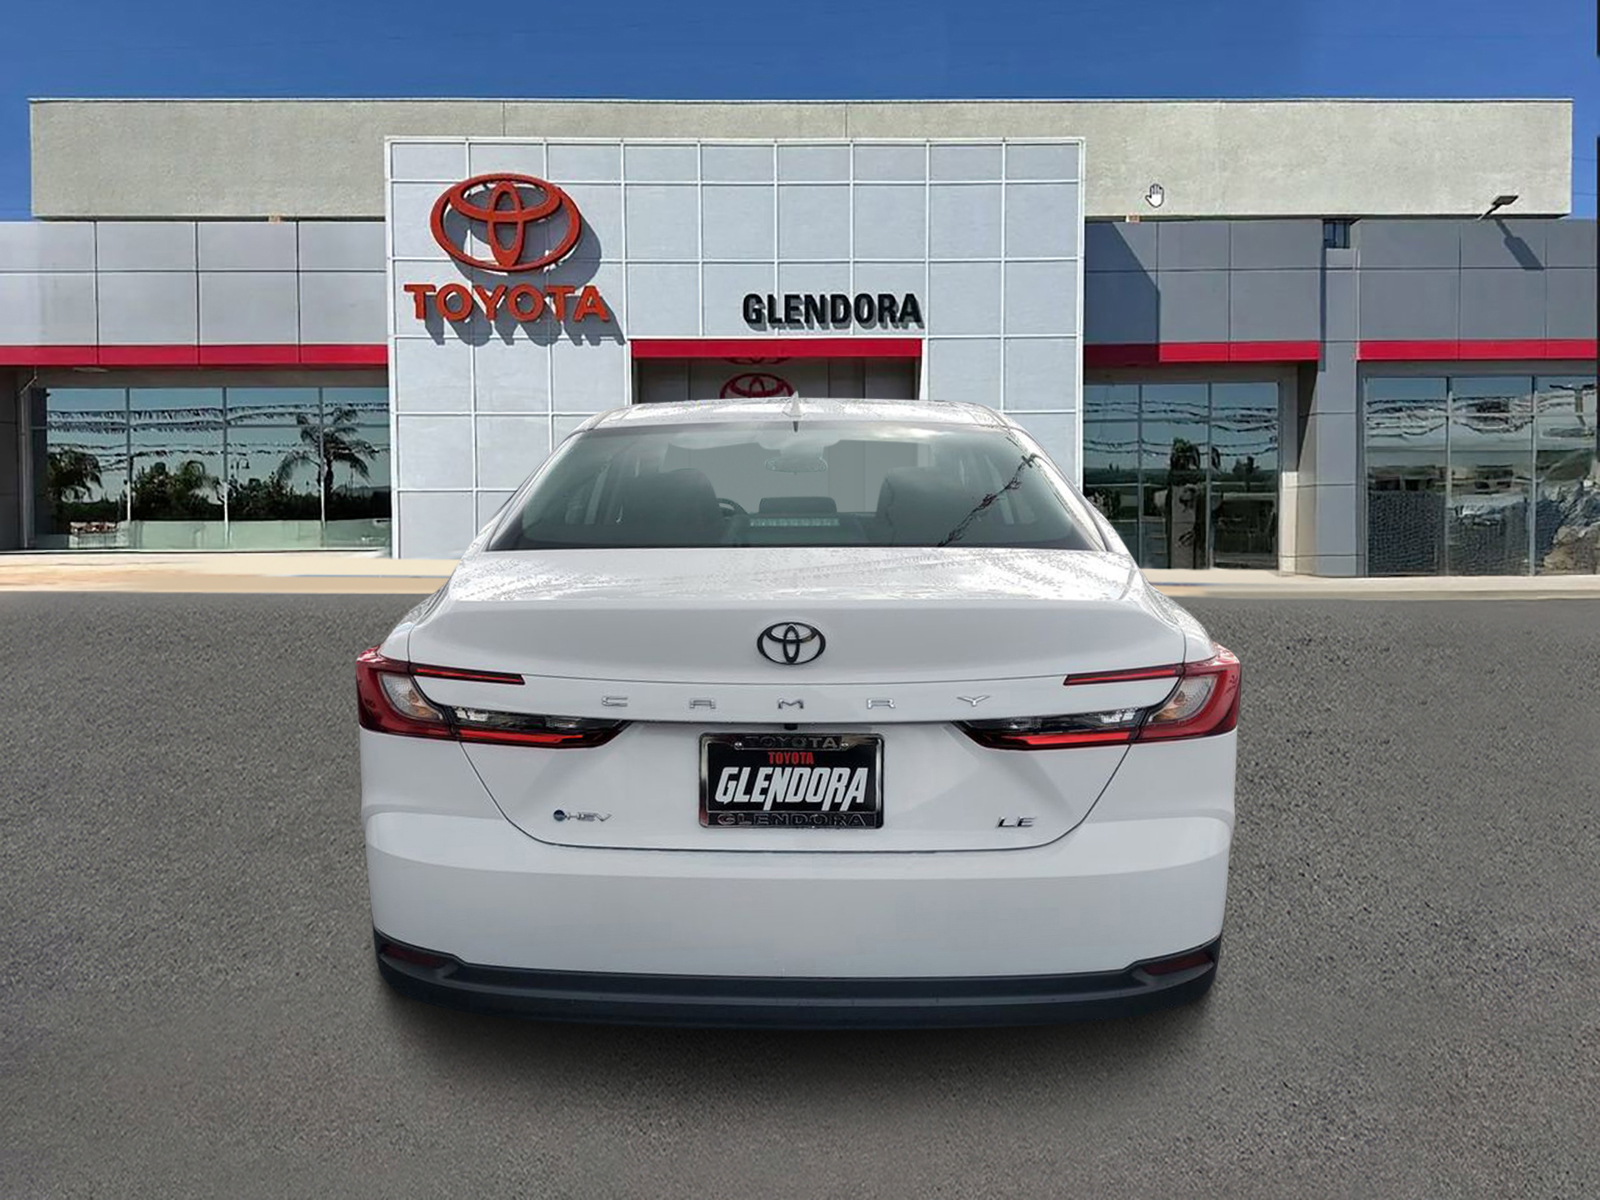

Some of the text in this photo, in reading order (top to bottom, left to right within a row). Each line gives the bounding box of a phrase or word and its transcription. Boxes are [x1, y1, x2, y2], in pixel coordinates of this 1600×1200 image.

[403, 283, 611, 323] TOYOTA
[743, 292, 923, 326] GLENDORA
[601, 694, 991, 710] CAMRY
[744, 736, 838, 749] TOYOTA
[768, 752, 815, 765] TOYOTA
[714, 767, 869, 811] GLENDORA
[717, 813, 868, 826] GLENDORA
[995, 816, 1038, 829] LE
